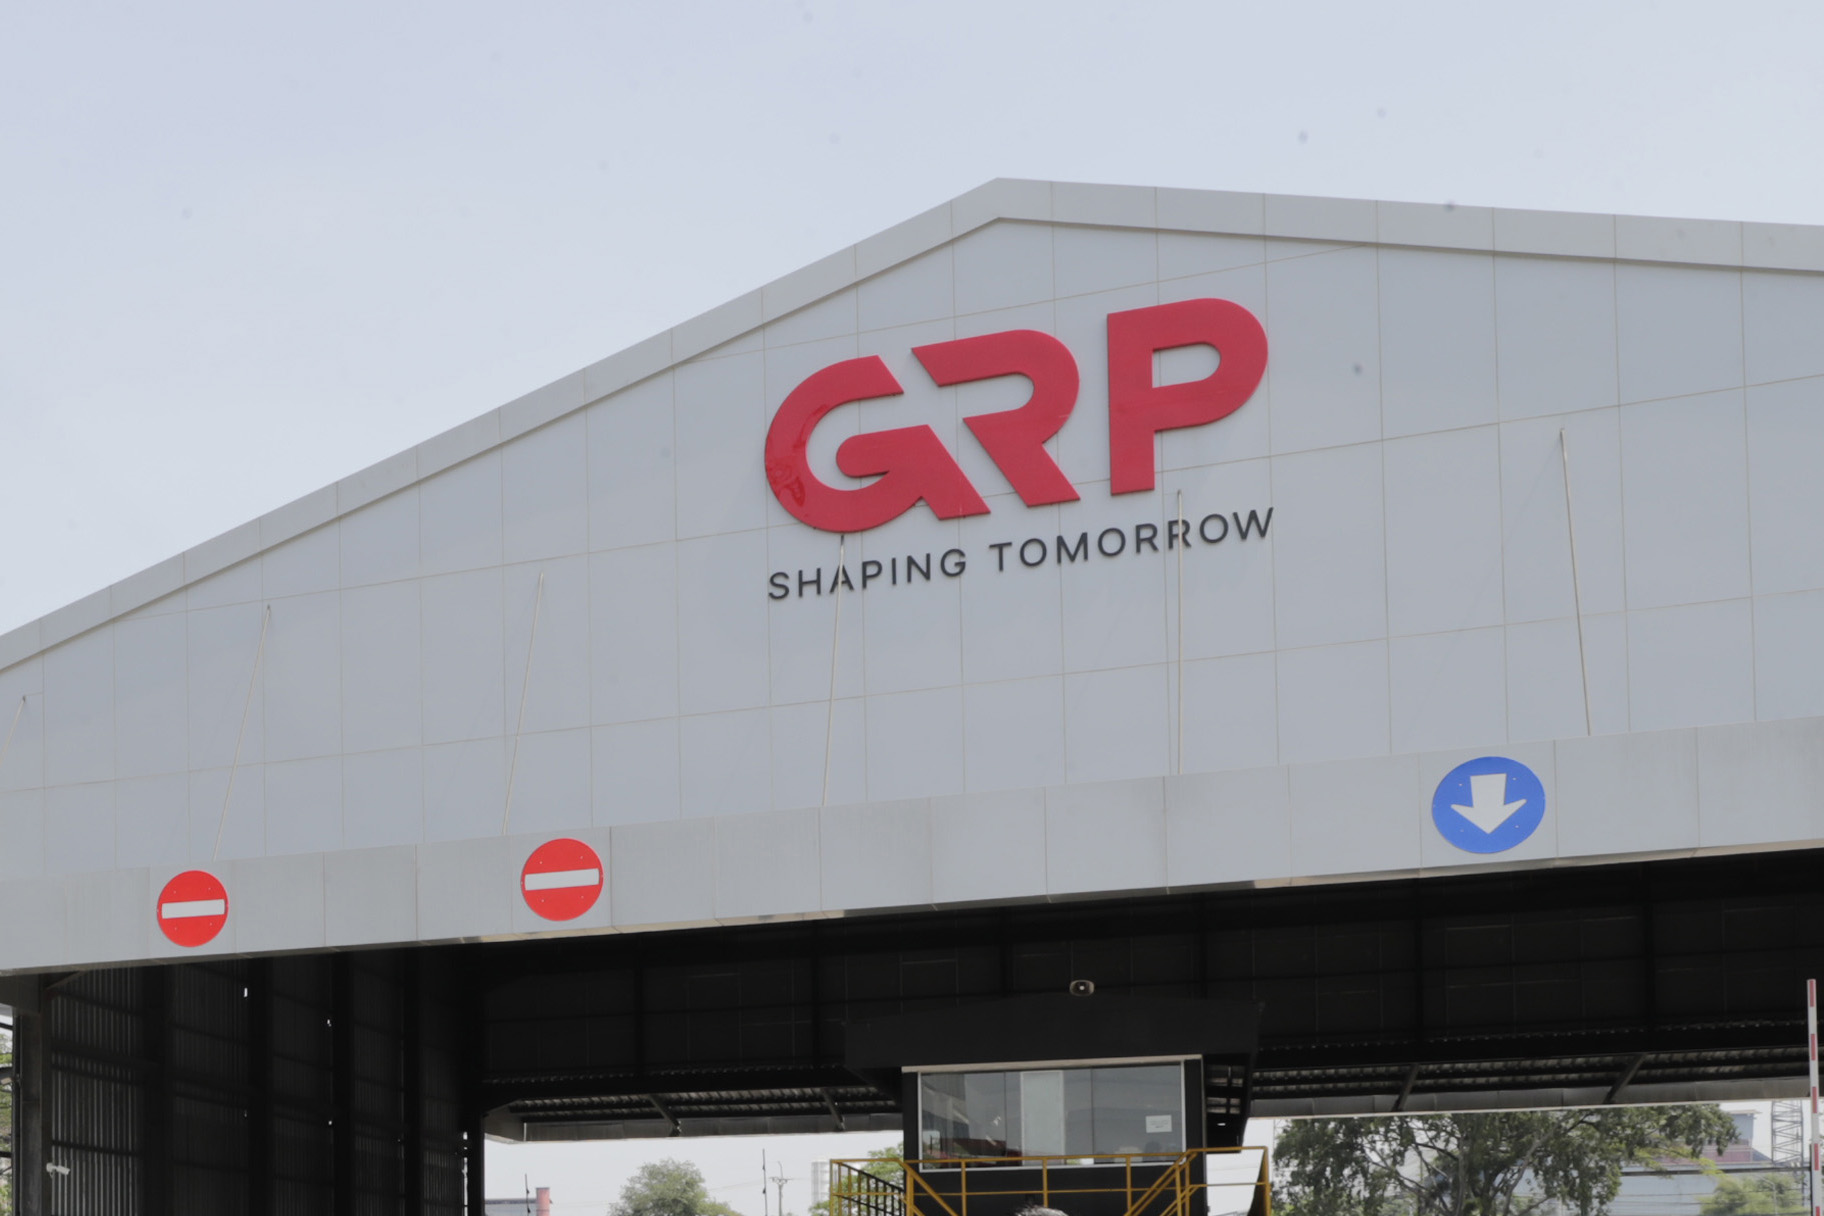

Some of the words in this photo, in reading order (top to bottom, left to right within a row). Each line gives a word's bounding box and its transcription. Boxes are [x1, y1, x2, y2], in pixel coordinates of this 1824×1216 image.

[764, 297, 1269, 533] GRP
[768, 547, 967, 600] SHAPING
[989, 507, 1275, 572] TOMORROW
